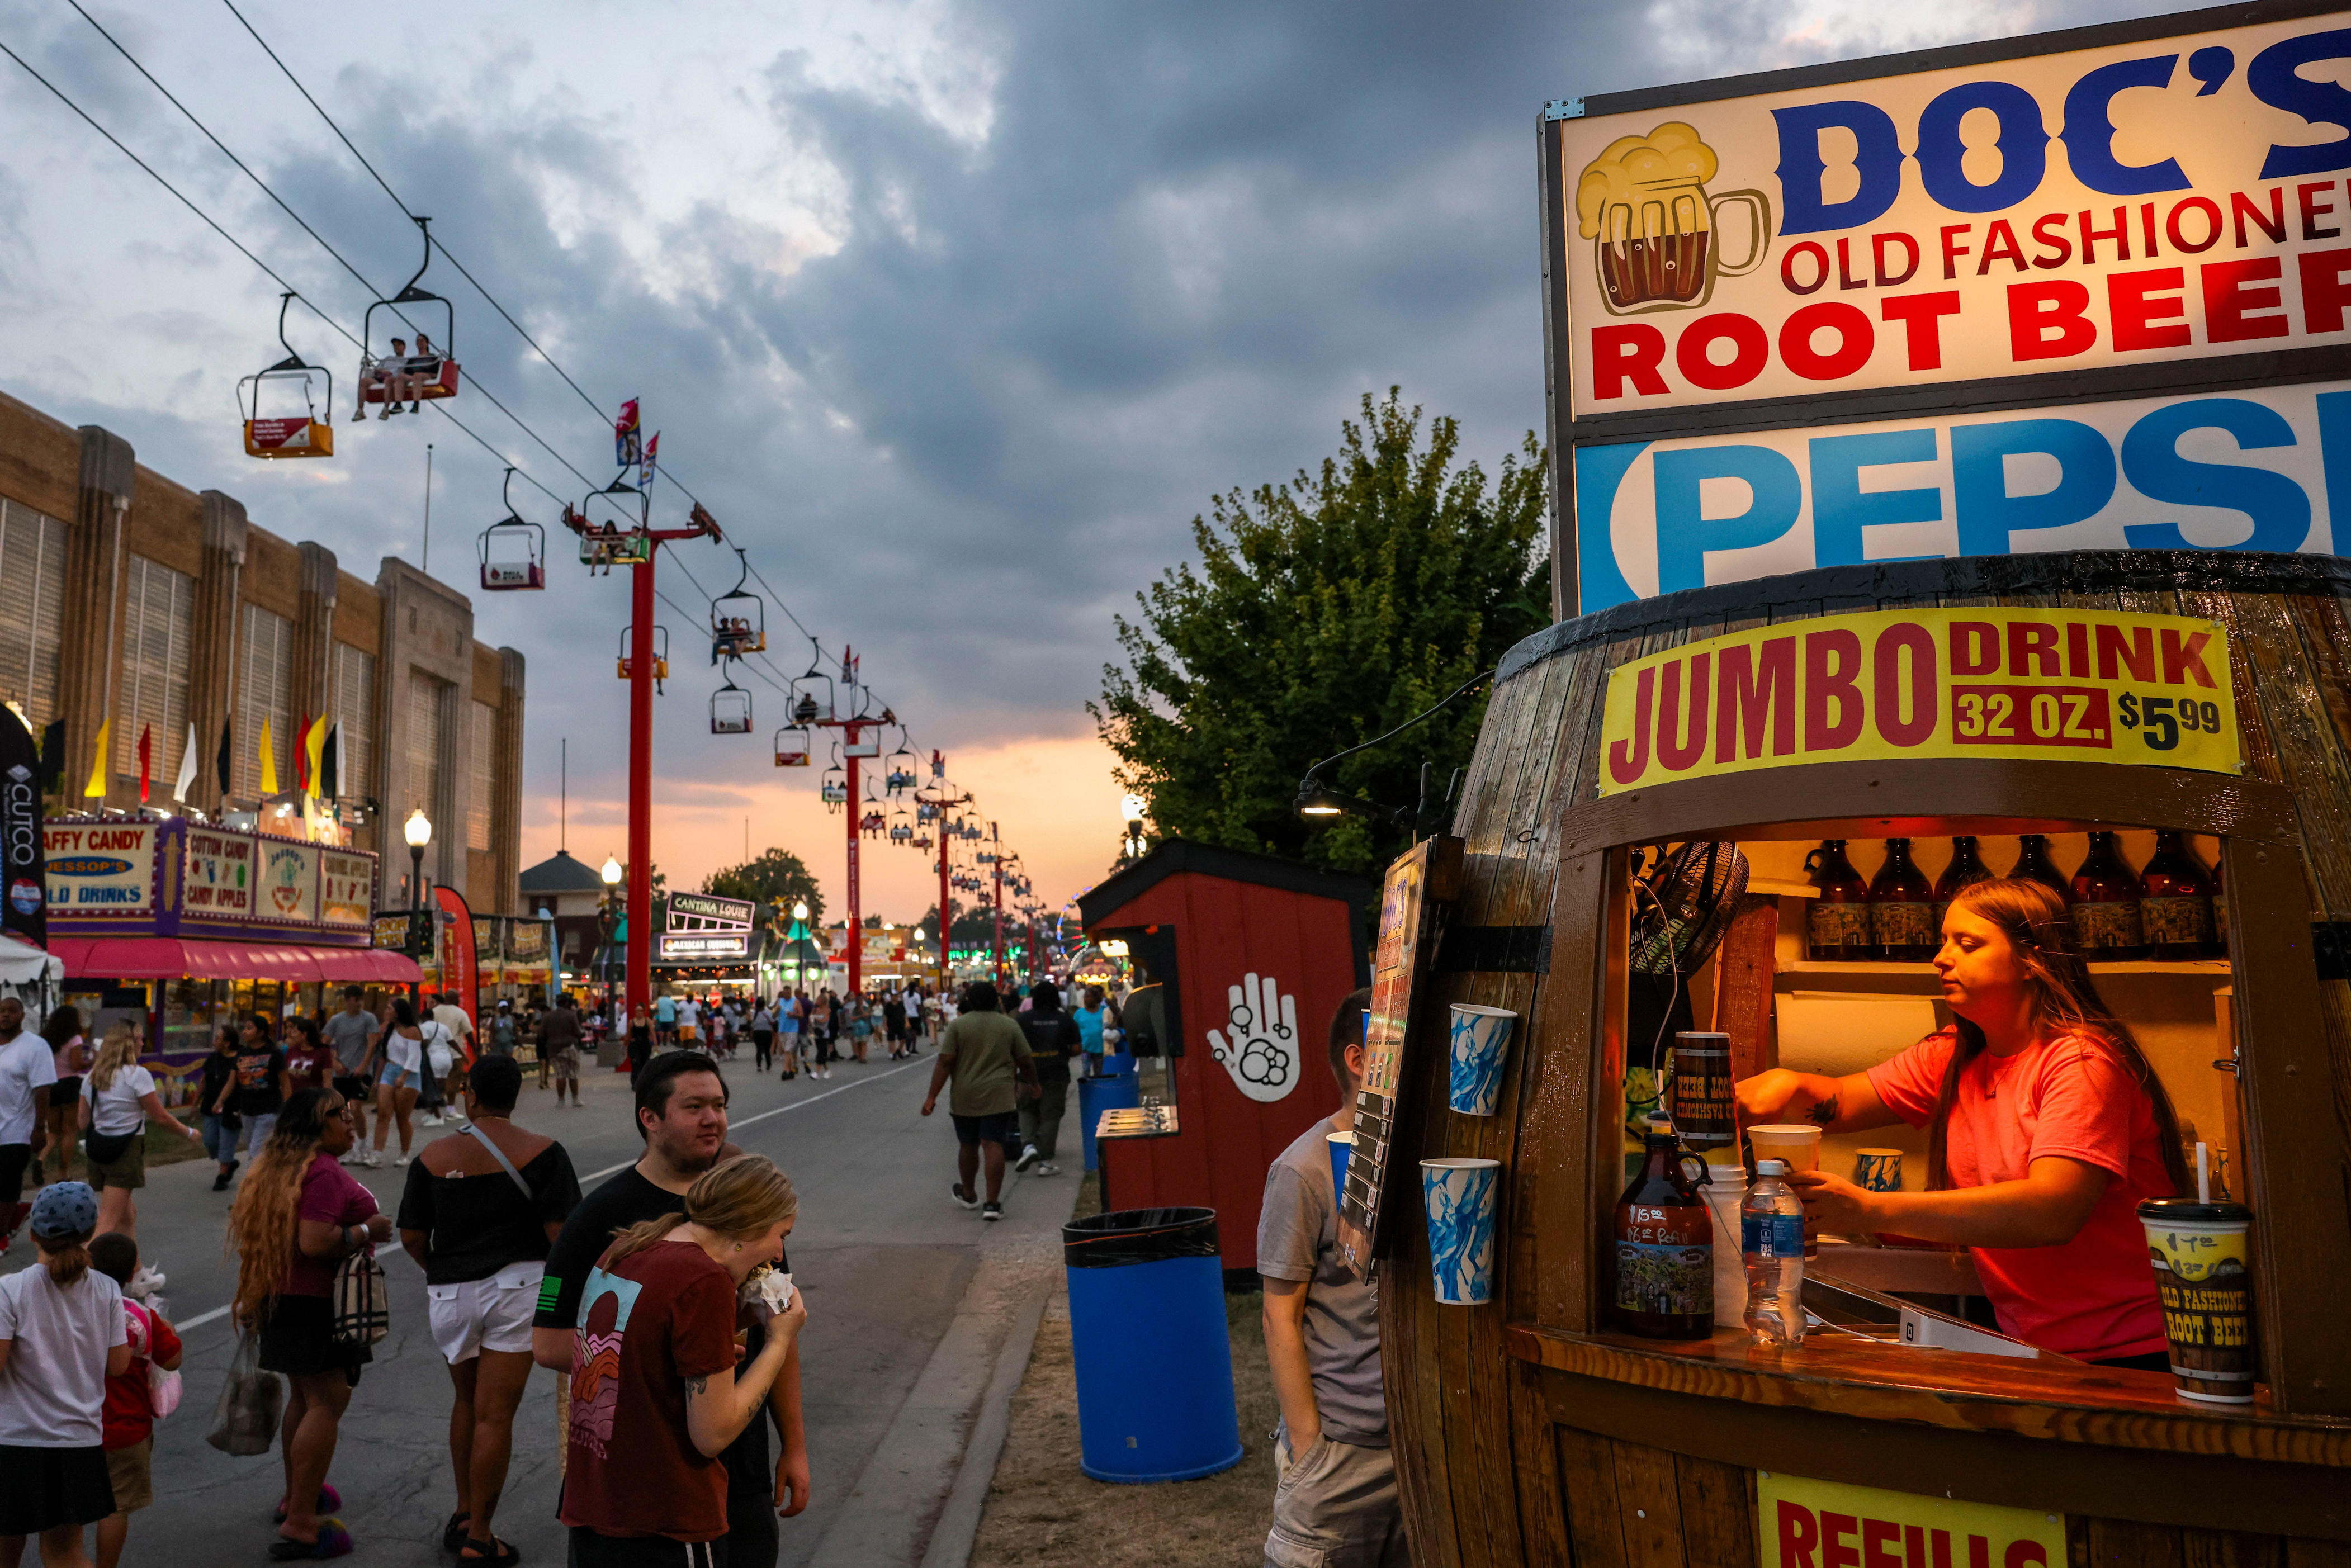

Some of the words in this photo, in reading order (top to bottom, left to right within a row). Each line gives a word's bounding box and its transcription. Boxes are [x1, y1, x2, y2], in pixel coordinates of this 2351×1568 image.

[1770, 28, 2351, 237] DOC'S
[1781, 231, 1920, 295] OLD
[1941, 178, 2351, 279] FASHIONE
[1591, 291, 1961, 400] ROOT
[1653, 390, 2351, 594] PEPSI
[1609, 622, 1938, 785] JUMBO
[1950, 621, 2218, 688] DRINK
[1957, 694, 2014, 737] 32
[2031, 694, 2105, 741] OZ.
[11, 784, 35, 865] CUTCO
[88, 831, 144, 850] CANDY
[45, 861, 126, 872] JESSOP'S
[78, 885, 141, 903] DRINKS
[674, 897, 717, 913] CANTINA
[719, 903, 748, 918] LOUIE
[2161, 1286, 2179, 1308] OLD
[2183, 1289, 2246, 1311] FASHIONE
[2166, 1312, 2204, 1344] ROOT
